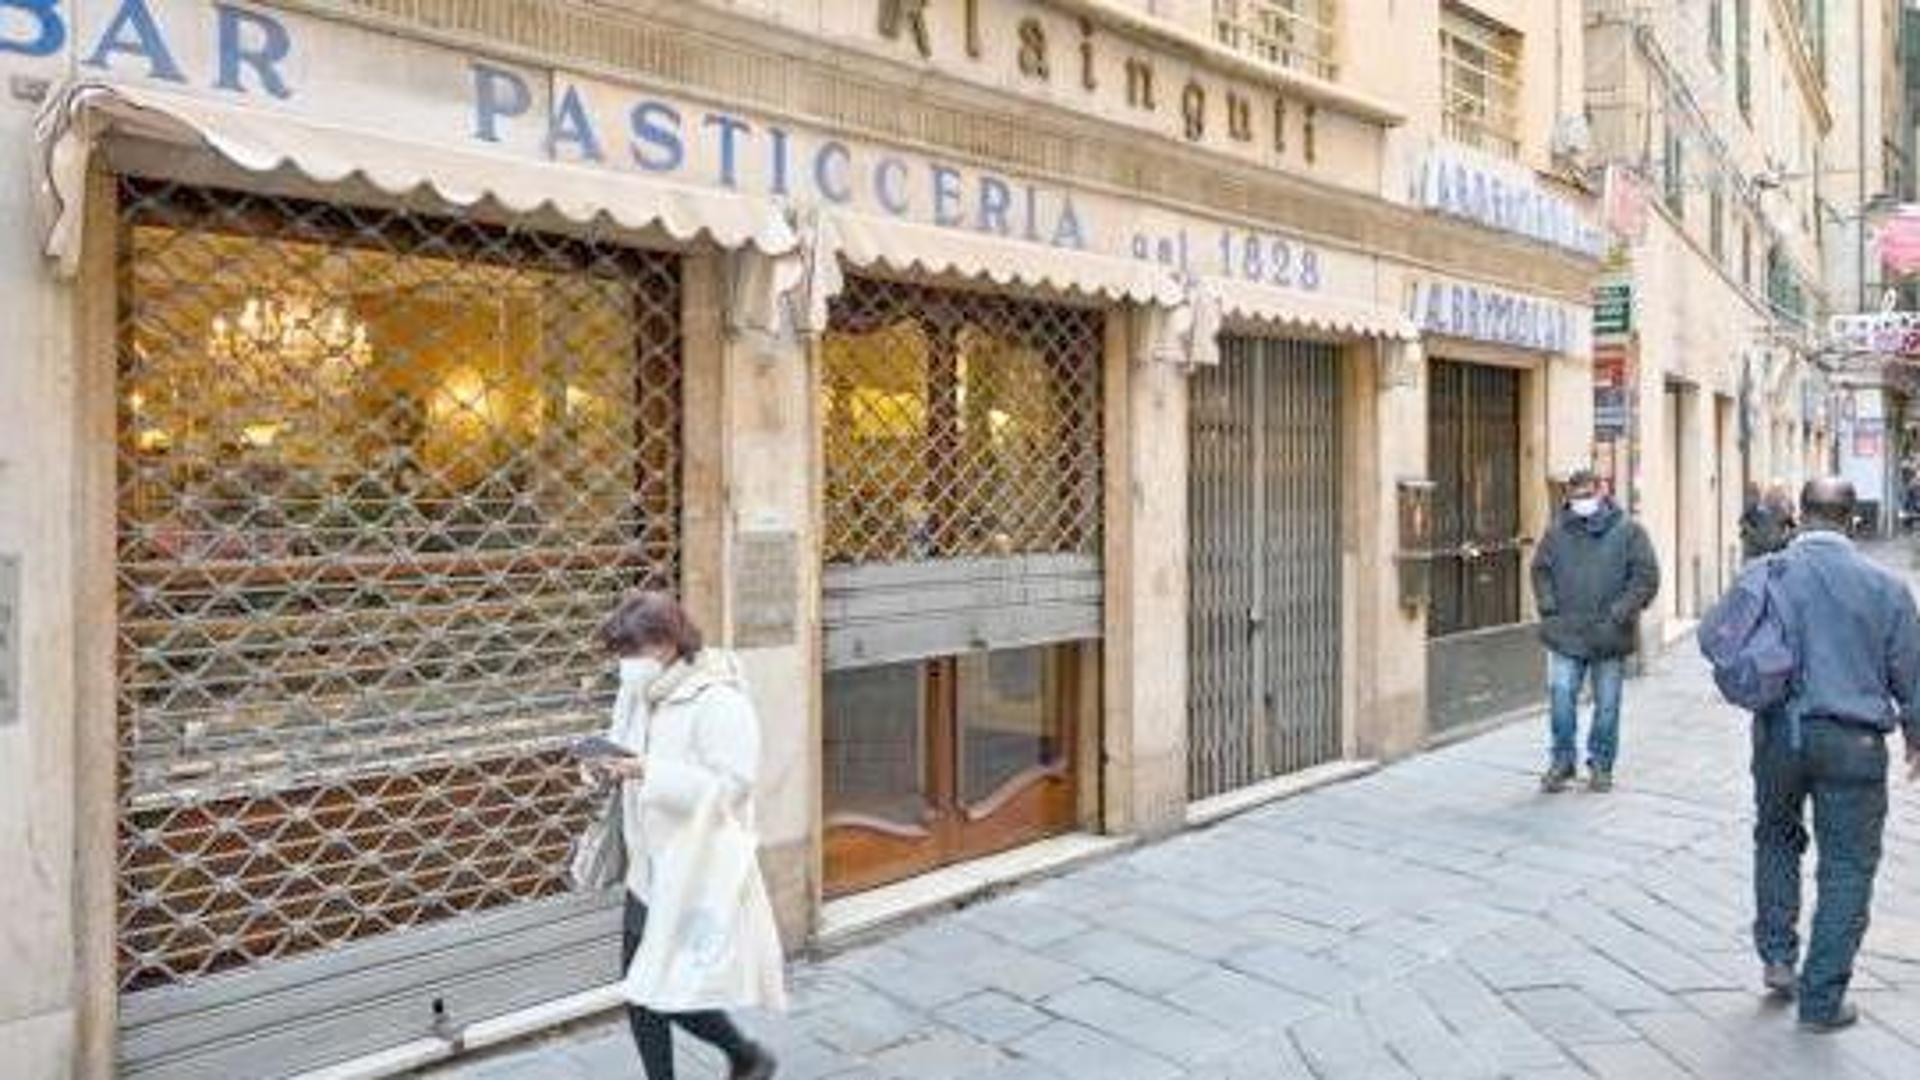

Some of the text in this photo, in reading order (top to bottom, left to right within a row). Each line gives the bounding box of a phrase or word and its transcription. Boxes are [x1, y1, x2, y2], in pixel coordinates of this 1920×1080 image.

[0, 0, 294, 99] BAR
[472, 62, 1086, 250] PASTICCERIA
[1219, 227, 1319, 291] 1828
